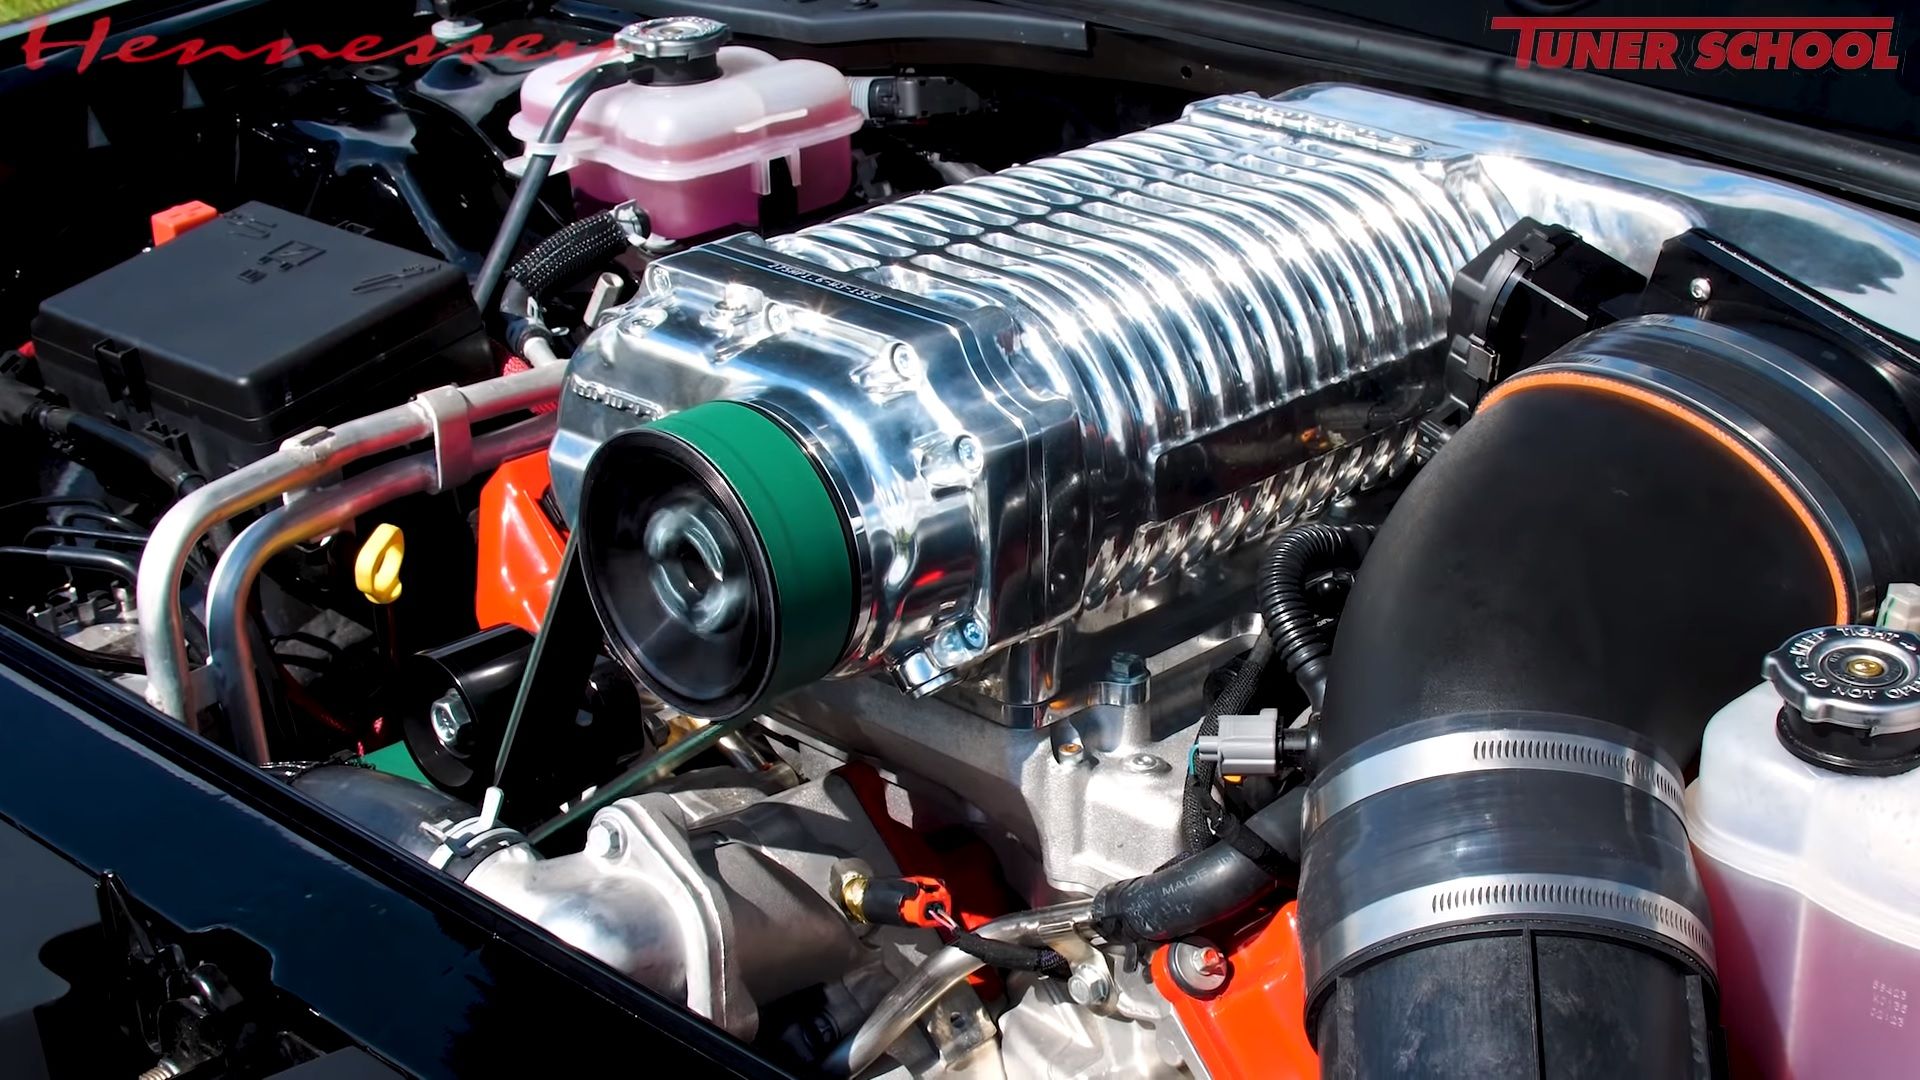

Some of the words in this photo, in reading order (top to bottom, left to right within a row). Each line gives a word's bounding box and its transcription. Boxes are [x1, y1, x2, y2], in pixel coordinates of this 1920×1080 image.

[1836, 627, 1900, 642] TIGHT
[1800, 672, 1831, 688] DO
[1831, 686, 1877, 699] NOT
[1162, 869, 1209, 896] MADE
